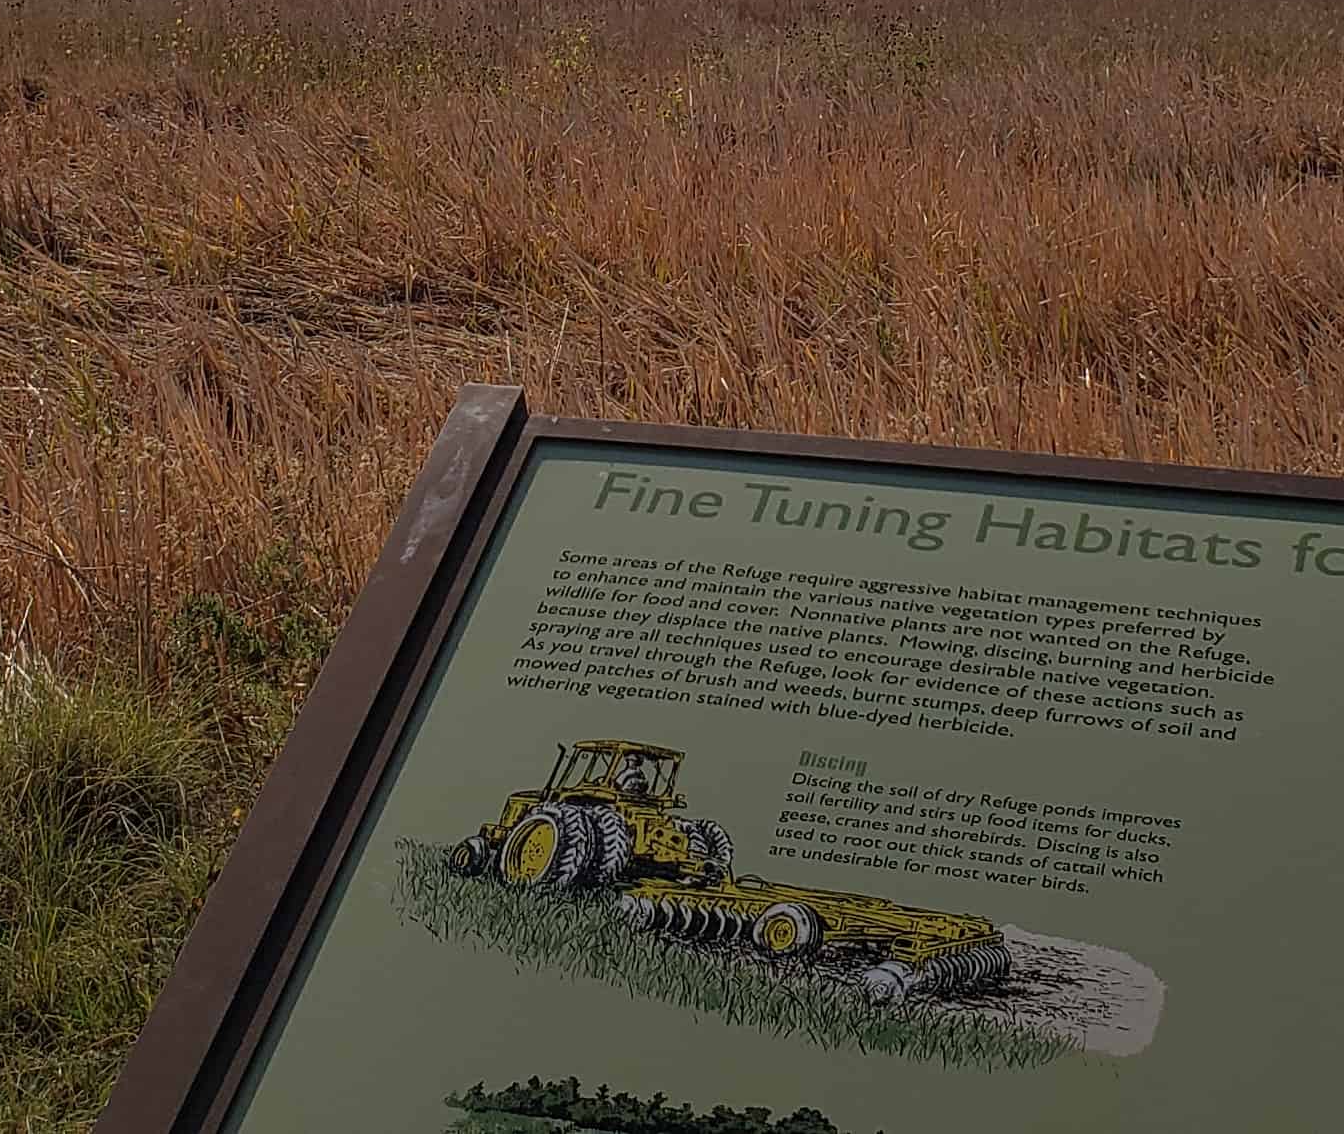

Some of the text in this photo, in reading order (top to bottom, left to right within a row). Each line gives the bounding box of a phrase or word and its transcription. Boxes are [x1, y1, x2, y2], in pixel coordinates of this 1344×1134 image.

[592, 470, 724, 520] Fine
[743, 481, 954, 553] Tuning
[974, 502, 1264, 570] Habitats
[546, 585, 606, 601] wildlife
[610, 588, 639, 604] for
[642, 591, 686, 608] food
[687, 597, 723, 612] and
[726, 602, 779, 618] cover.
[789, 605, 887, 628] Nonnative
[890, 615, 947, 634] plants
[951, 624, 984, 637] are
[989, 628, 1024, 642] not
[1028, 632, 1101, 650] wanted
[1106, 640, 1132, 653] on
[1139, 640, 1172, 657] the
[552, 569, 1227, 647] to enhance and maintain the various native vegetation types preferred by
[558, 549, 1262, 629] Some areas of the Refuge require aggressive habitat management techniques
[528, 621, 1216, 700] spraying are all techniques used to encourage desirable native vegetation.
[536, 600, 608, 619] because
[612, 607, 653, 627] they
[656, 610, 728, 631] displace
[733, 618, 763, 634] the
[768, 624, 824, 640] native
[826, 627, 889, 647] plants.
[1057, 649, 1133, 676] burning
[1137, 661, 1175, 676] and
[1180, 662, 1275, 686] herbicide
[507, 674, 1015, 738] withering vegetation stained with blue-dyed herbicide.
[513, 657, 583, 673] mowed
[583, 662, 656, 680] patches
[660, 667, 684, 683] of
[684, 668, 738, 689] brush
[742, 677, 779, 693] and
[852, 685, 907, 706] burnt
[990, 701, 1039, 724] deep
[1045, 706, 1125, 730] furrows
[1130, 717, 1156, 733] of
[1156, 721, 1194, 737] soil
[1198, 726, 1238, 742] and
[798, 750, 868, 777] Discing
[791, 771, 1182, 829] Discing the soil of dry Refuge ponds improves
[768, 845, 1090, 895] are undesirable for most water birds.
[775, 827, 1164, 884] used to root out thick stands of cattail which
[834, 816, 890, 832] cranes
[893, 822, 927, 837] and
[930, 824, 1027, 849] shorebirds.
[1036, 836, 1102, 861] Discing
[1105, 844, 1120, 859] is
[1123, 847, 1160, 864] also
